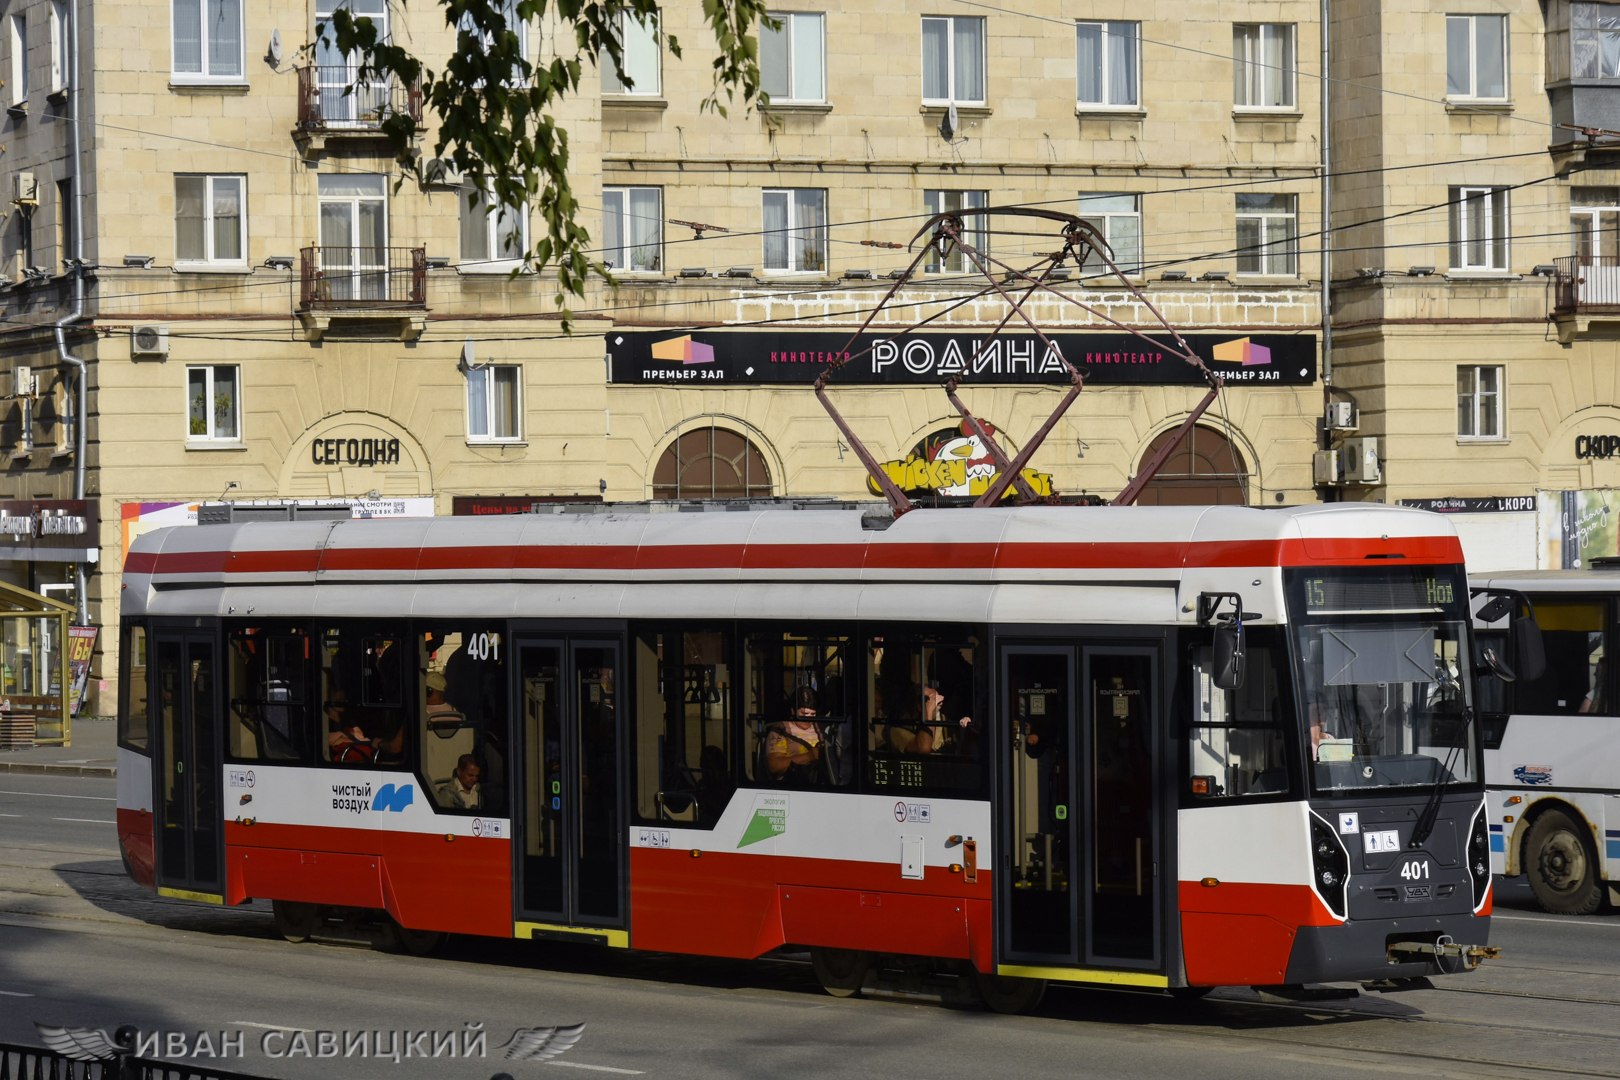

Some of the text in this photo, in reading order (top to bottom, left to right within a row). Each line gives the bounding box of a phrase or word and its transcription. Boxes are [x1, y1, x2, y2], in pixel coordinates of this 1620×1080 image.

[770, 339, 1162, 376] КИНОТЕАТР РОДИНА КИНОТЕАТР
[643, 370, 724, 379] ПРЕМЬЕР ЗАЛ
[1204, 371, 1280, 380] РЕМЬЕР ЗАЛ
[312, 438, 400, 468] СЕГОДНЯ
[1575, 435, 1620, 460] СКОР
[472, 504, 502, 515] Цены
[1430, 498, 1534, 511] РОДИНА СКОРО
[1306, 579, 1325, 606] 15
[467, 632, 499, 661] 401
[332, 782, 371, 797] чистый
[332, 799, 369, 814] воздух
[1400, 860, 1430, 880] 401
